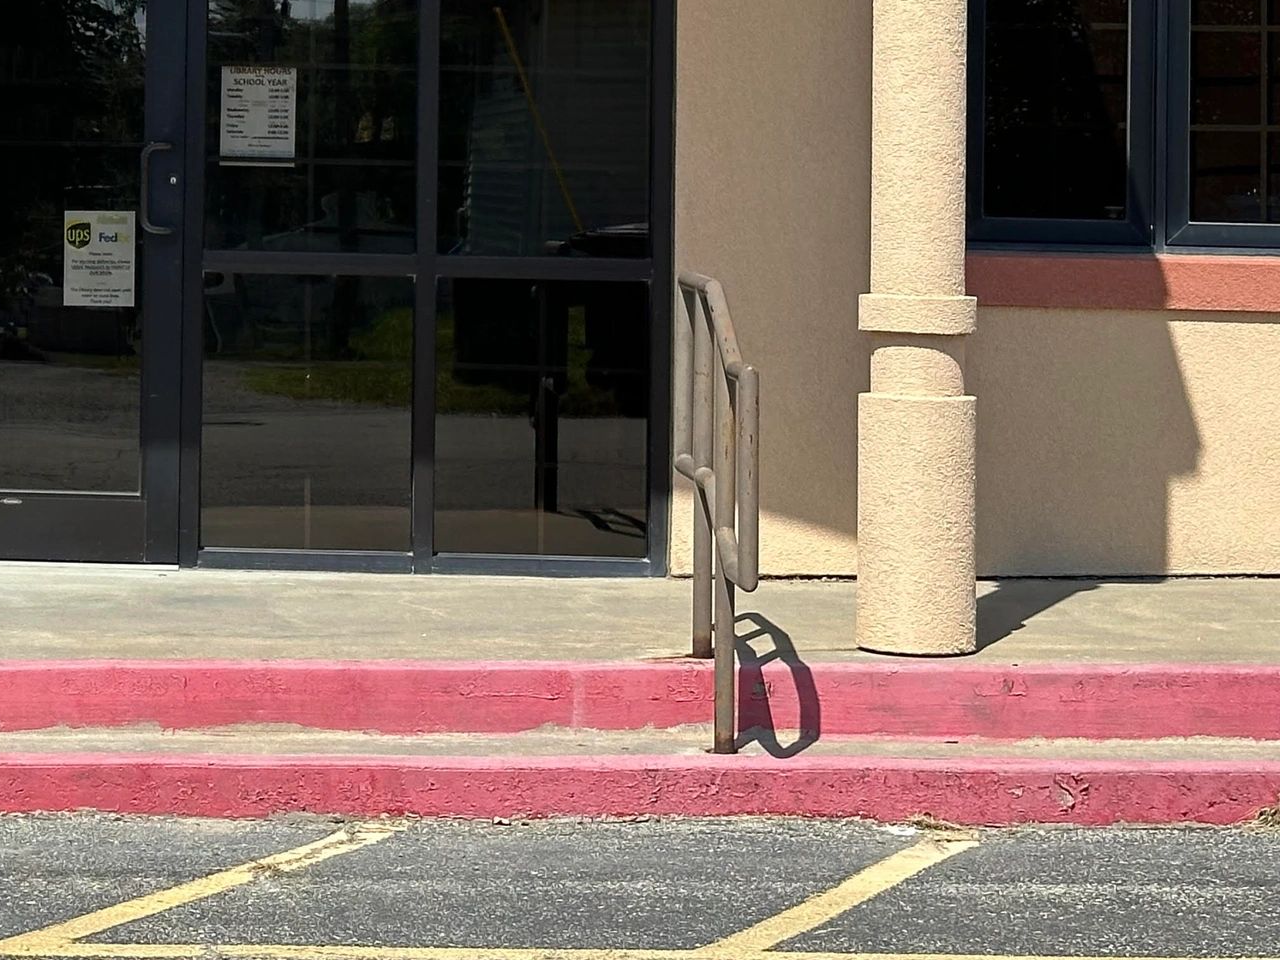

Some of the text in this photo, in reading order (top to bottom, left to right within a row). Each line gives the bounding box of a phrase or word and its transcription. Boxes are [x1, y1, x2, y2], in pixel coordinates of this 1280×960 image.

[230, 66, 292, 75] LIBRARY HOURS
[233, 78, 288, 86] SCHOOL YEAR
[67, 229, 90, 246] ups
